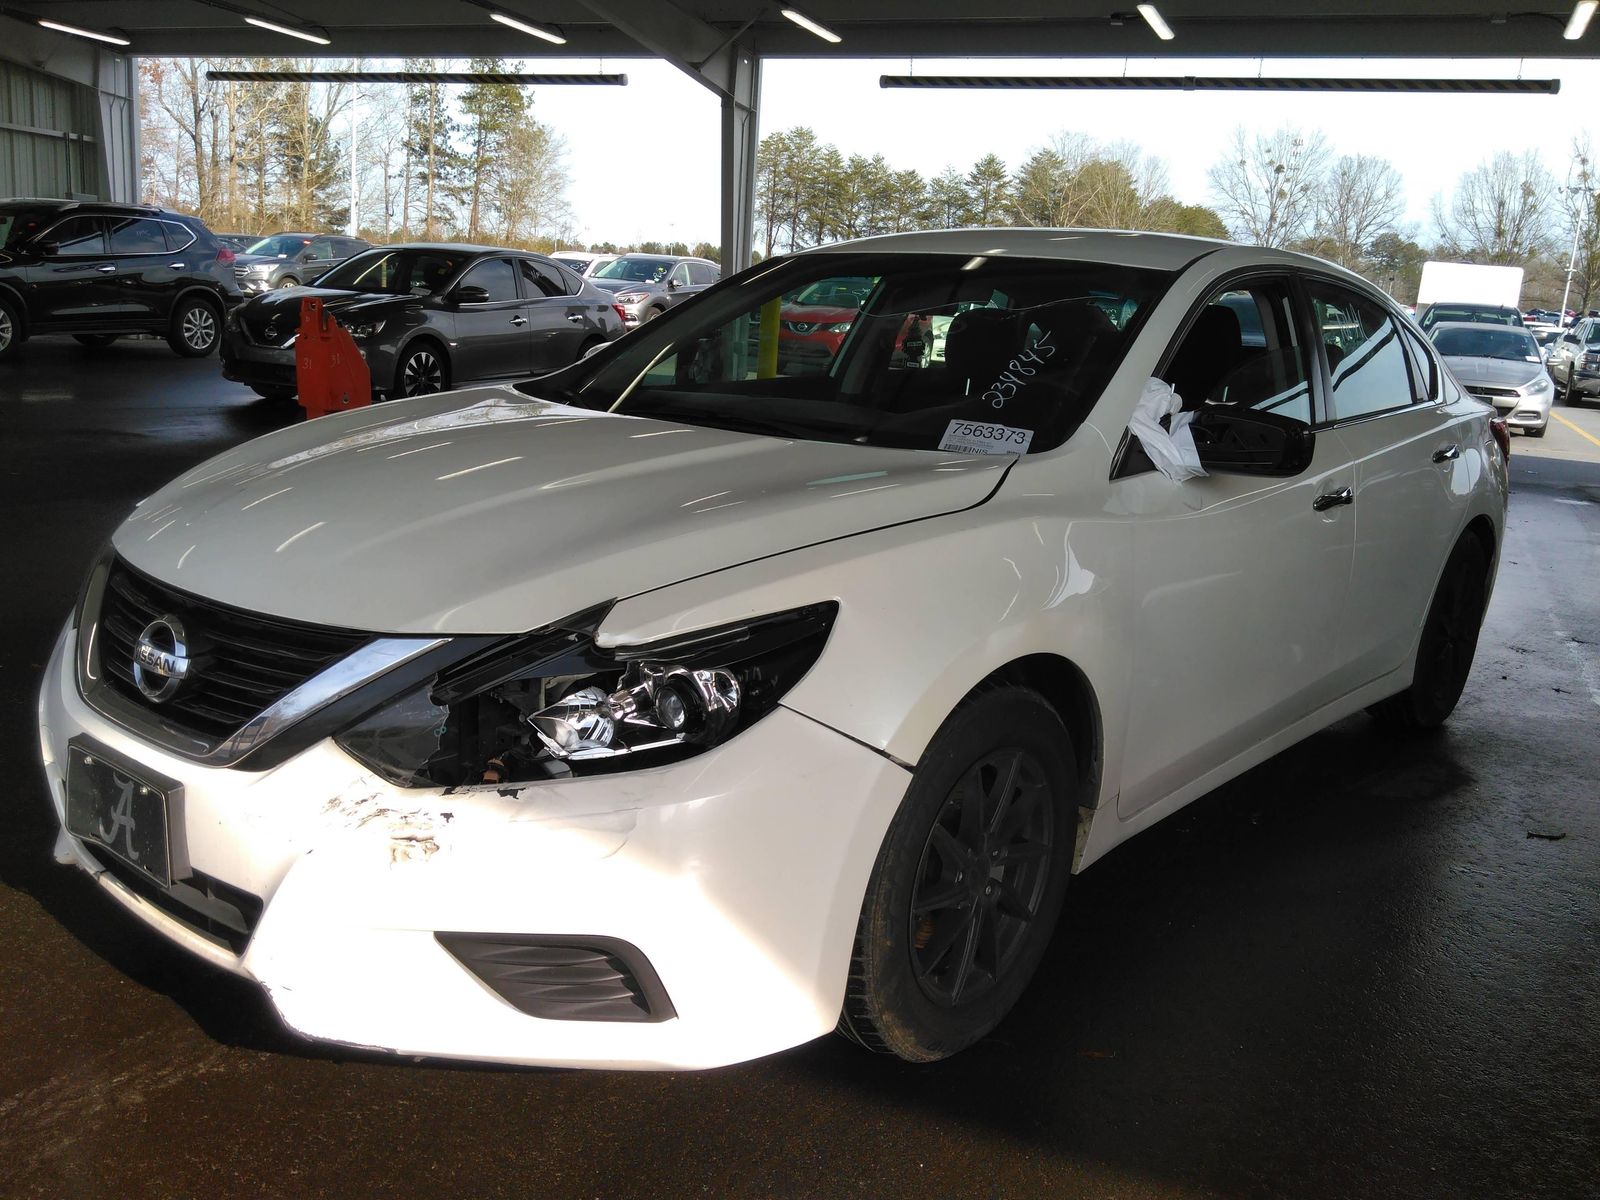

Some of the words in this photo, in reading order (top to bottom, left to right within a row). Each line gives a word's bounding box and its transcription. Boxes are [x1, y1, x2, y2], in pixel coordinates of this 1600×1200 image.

[982, 330, 1056, 409] 234845
[951, 422, 1027, 445] 7563373
[99, 771, 140, 861] A
